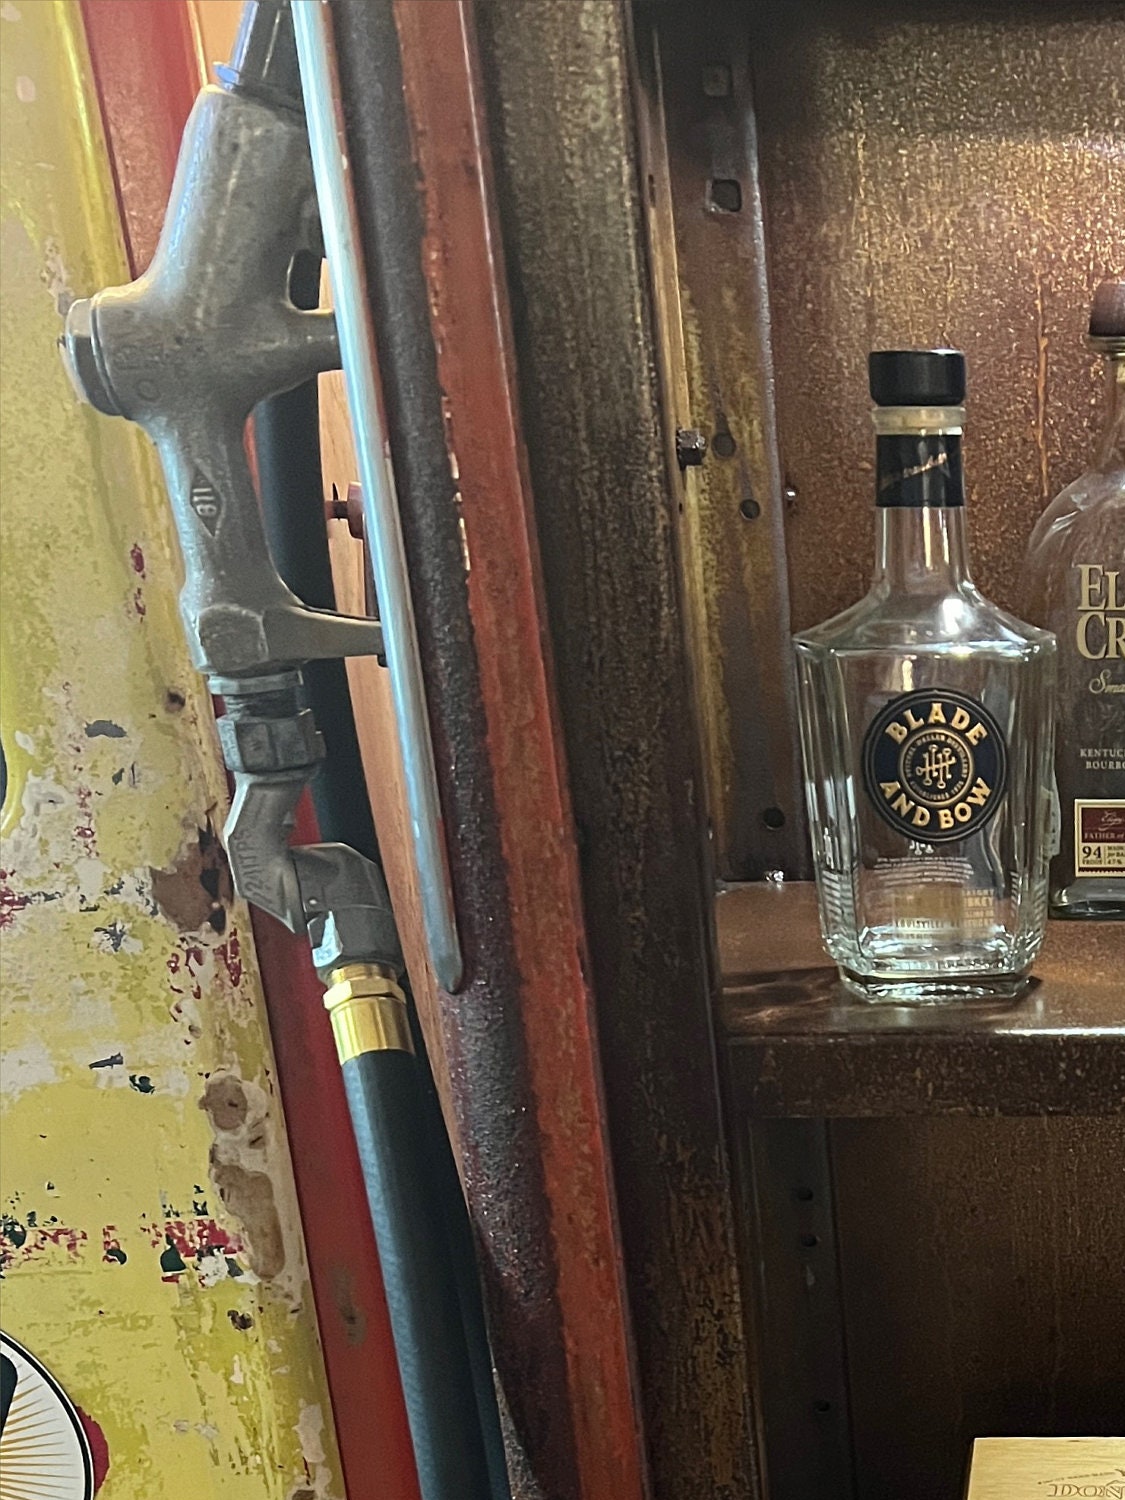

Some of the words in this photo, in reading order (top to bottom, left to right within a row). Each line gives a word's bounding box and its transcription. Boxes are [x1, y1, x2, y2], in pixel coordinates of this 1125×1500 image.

[885, 702, 988, 746] BLADE
[879, 780, 931, 827] AND
[937, 777, 992, 829] BOW
[1082, 845, 1102, 859] 94
